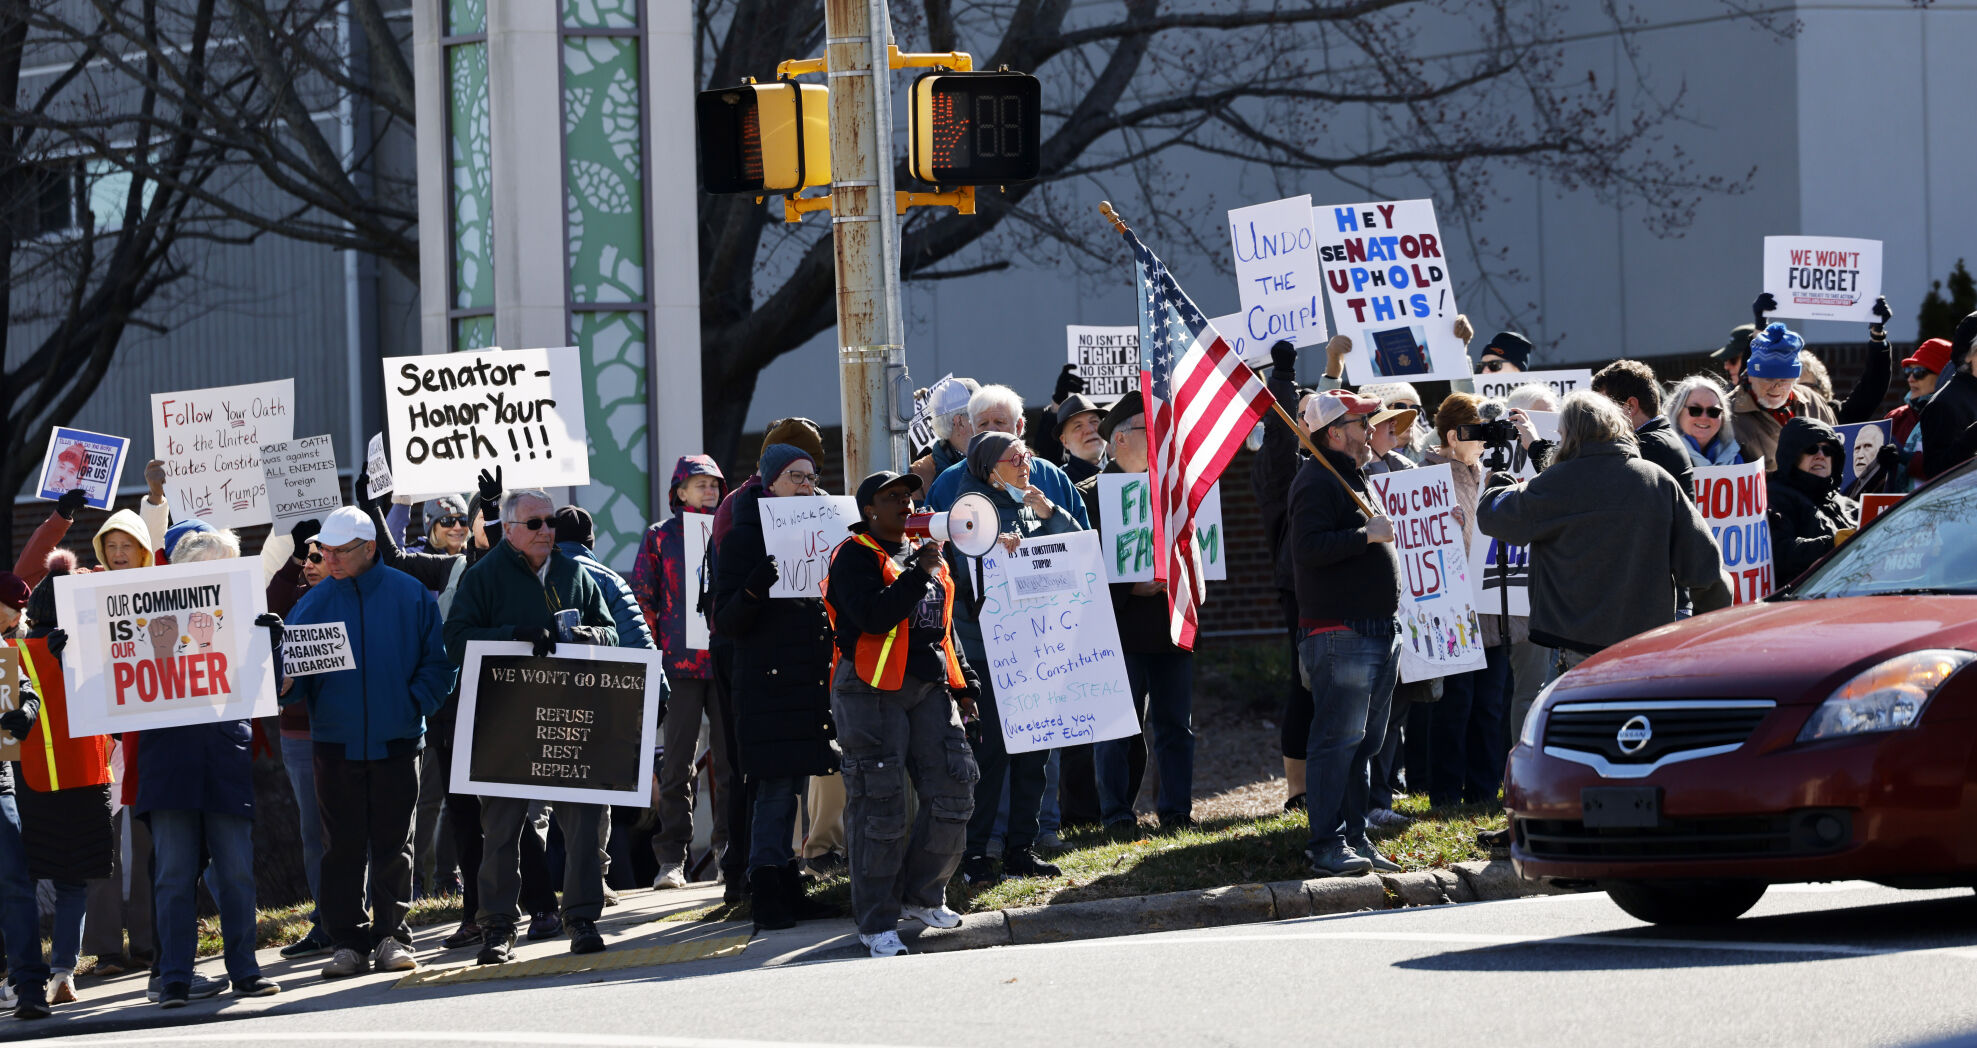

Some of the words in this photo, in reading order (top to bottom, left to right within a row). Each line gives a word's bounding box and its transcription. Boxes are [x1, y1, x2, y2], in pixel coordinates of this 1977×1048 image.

[1334, 204, 1395, 233] HEY
[1320, 233, 1441, 263] SENATOR
[1790, 249, 1812, 266] WE
[1816, 250, 1860, 269] WON'T
[1254, 271, 1296, 295] THE
[1327, 263, 1444, 294] UPHOLD
[1789, 267, 1860, 292] FORGET
[1078, 335, 1093, 346] NO
[1096, 334, 1123, 346] ISN'T
[1127, 335, 1139, 346] EN
[1079, 347, 1124, 365] FIGHT
[397, 357, 526, 396] Senator
[1080, 365, 1095, 377] NO
[1097, 365, 1124, 376] ISN'T
[1129, 365, 1141, 376] EN
[162, 400, 213, 428] Follow
[221, 400, 245, 421] Your
[252, 397, 286, 419] Oath
[408, 401, 489, 432] Honor
[486, 391, 556, 425] Your
[168, 435, 184, 456] to
[193, 433, 214, 451] the
[215, 425, 257, 449] United
[260, 443, 288, 454] YOUR
[301, 436, 328, 449] OATH
[84, 453, 110, 468] MUSK
[166, 458, 207, 478] States
[214, 453, 262, 473] Constitu
[262, 454, 281, 464] was
[286, 449, 320, 463] against
[80, 465, 93, 478] OR
[94, 468, 107, 480] US
[266, 468, 285, 478] ALL
[289, 460, 335, 474] ENEMIES
[285, 477, 316, 489] foreign
[297, 489, 304, 497] &
[181, 485, 213, 511] Not
[220, 479, 266, 507] Trumps
[1373, 478, 1407, 516] You
[1694, 469, 1767, 519] HONO
[804, 529, 830, 558] US
[1020, 547, 1030, 557] THE
[1031, 542, 1068, 556] CONSTITUTION,
[1032, 558, 1052, 570] STUPID!
[783, 558, 815, 592] NOT
[107, 594, 130, 617] OUR
[132, 584, 221, 615] COMMUNITY
[109, 620, 133, 642] IS
[284, 627, 341, 642] MERICANS
[993, 624, 1017, 644] for
[111, 641, 136, 659] OUR
[289, 642, 335, 659] AGAINST
[994, 651, 1018, 669] and
[1034, 642, 1066, 658] the
[284, 656, 345, 675] OLIGARCHY
[1036, 648, 1115, 681] Constitution
[113, 651, 232, 706] POWER
[492, 668, 516, 682] WE
[521, 668, 570, 686] WON'T
[574, 672, 595, 687] GO
[600, 673, 645, 690] BACK!
[1002, 694, 1040, 717] STOP
[1047, 691, 1067, 705] the
[535, 706, 595, 724] REFUSE
[536, 725, 591, 741] RESIST
[542, 744, 582, 760] REST
[531, 762, 591, 779] REPEAT
